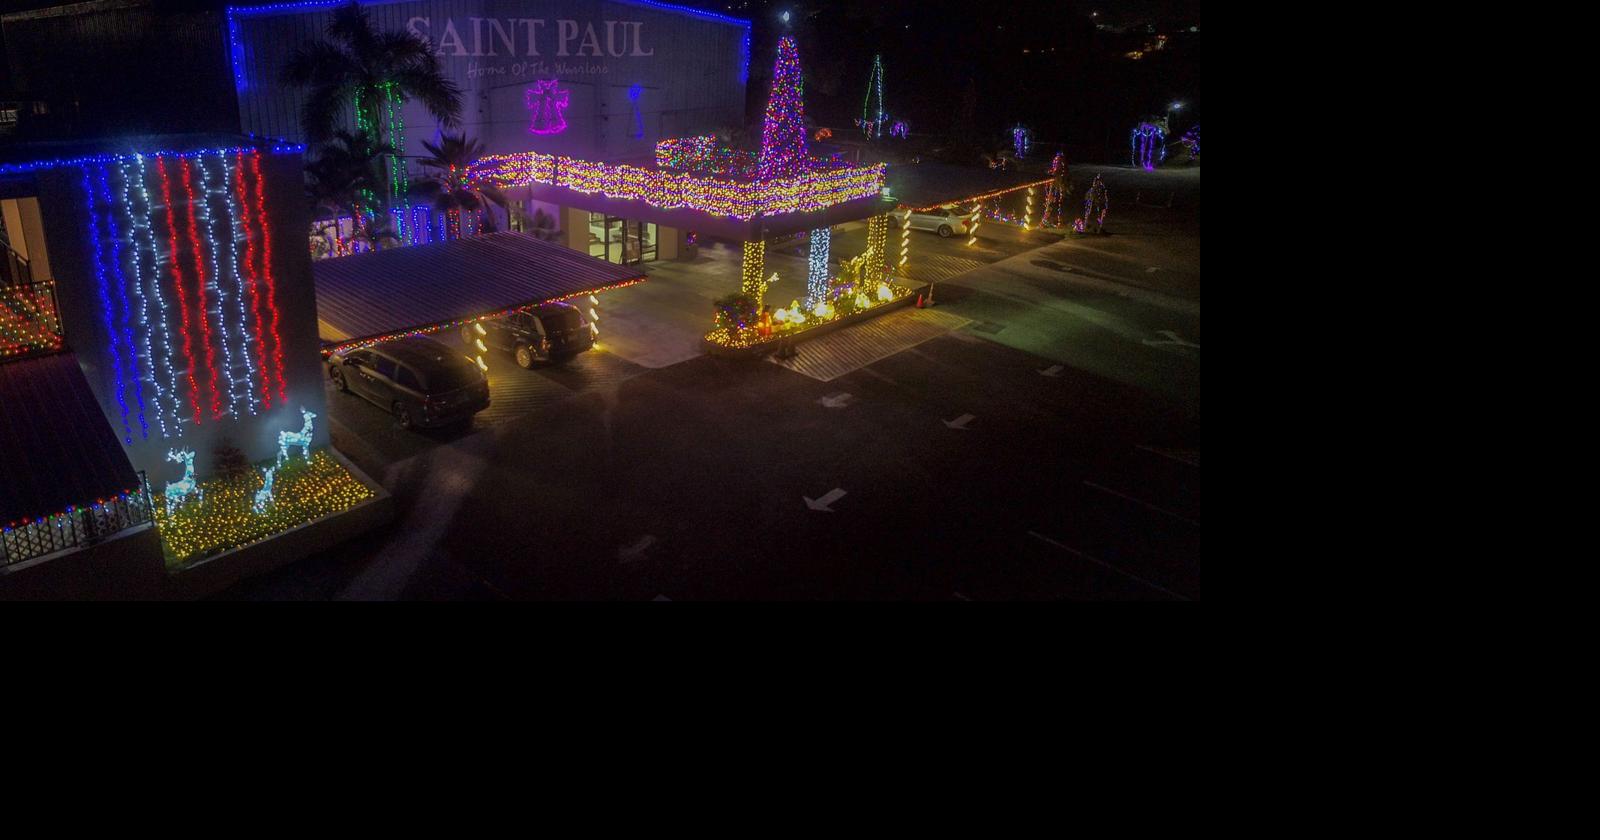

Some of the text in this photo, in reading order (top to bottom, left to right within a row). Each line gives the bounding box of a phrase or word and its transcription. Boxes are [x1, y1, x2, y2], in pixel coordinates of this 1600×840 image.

[407, 16, 655, 57] SAINT PAUL
[467, 62, 507, 79] Home
[511, 63, 528, 77] Of
[530, 61, 550, 75] The
